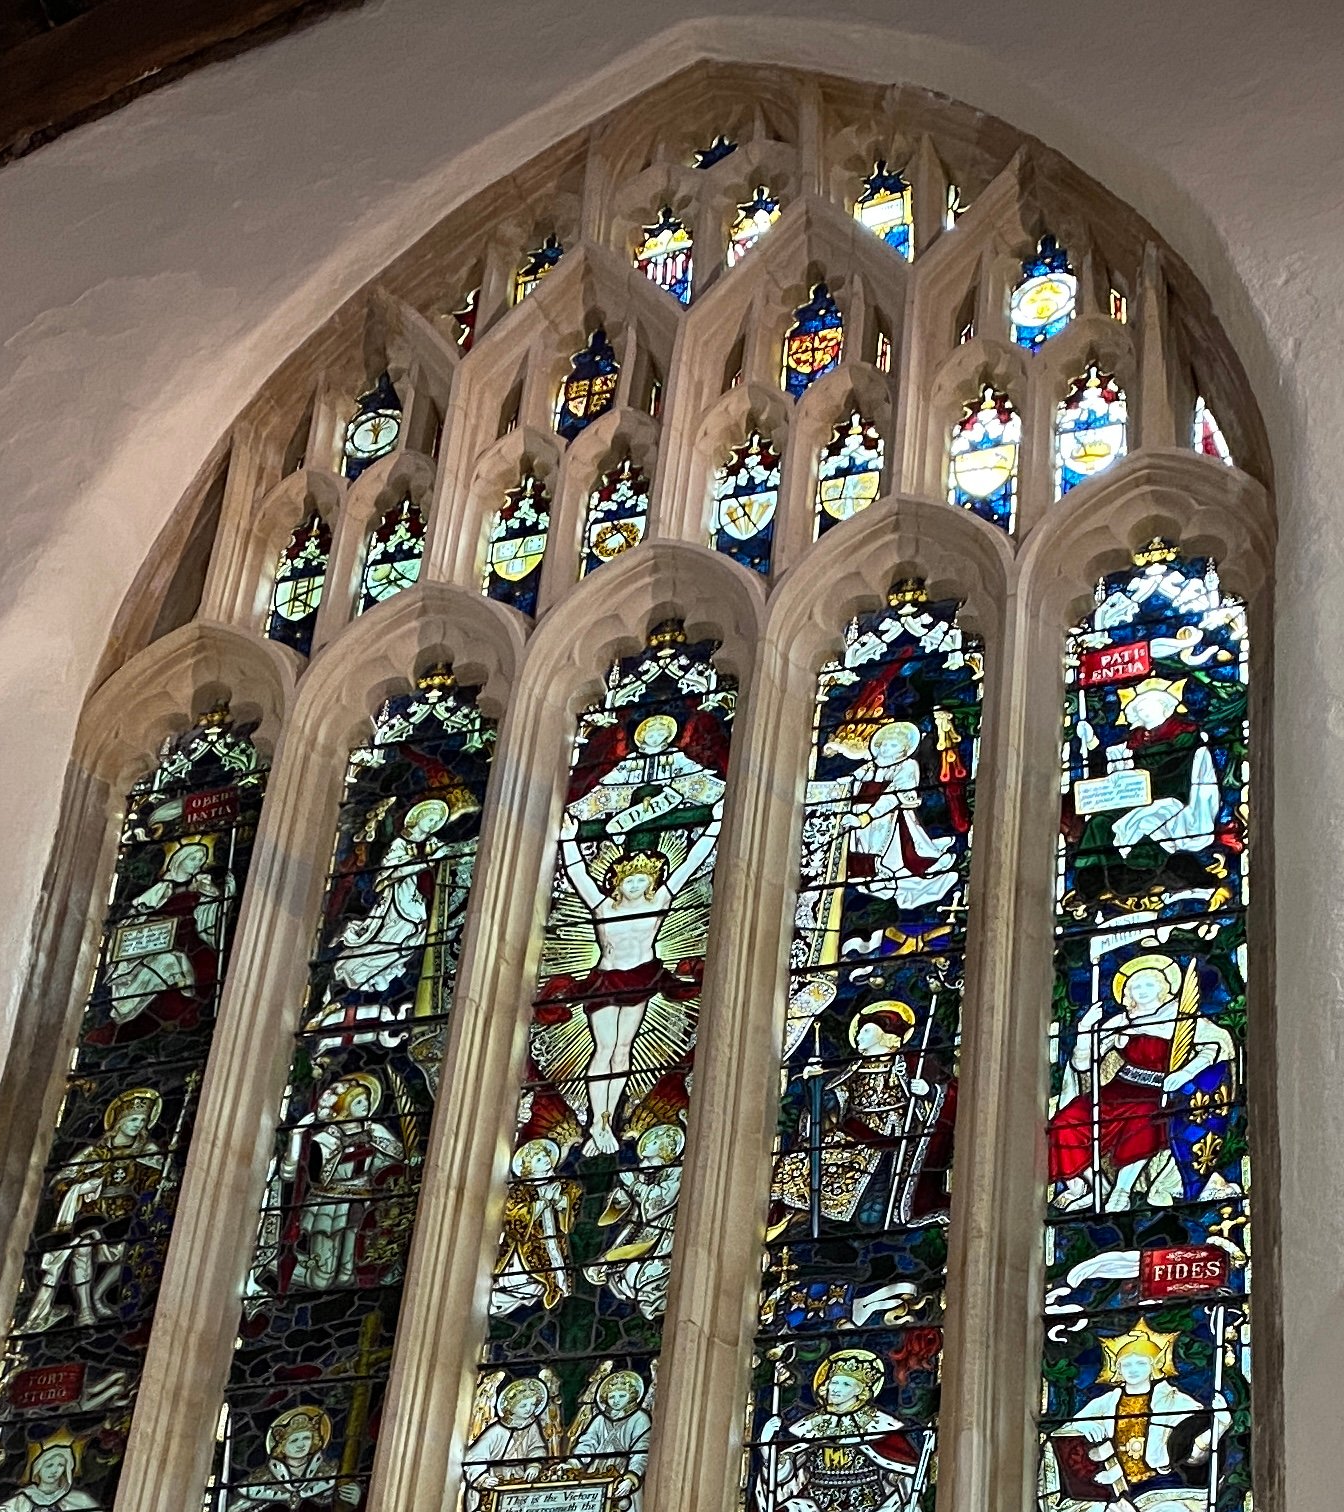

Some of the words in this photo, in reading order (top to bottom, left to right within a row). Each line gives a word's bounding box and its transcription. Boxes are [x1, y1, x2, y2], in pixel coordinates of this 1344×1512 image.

[1154, 1260, 1221, 1282] FIDES
[506, 1494, 528, 1507] This
[544, 1492, 558, 1503] the
[562, 1491, 599, 1505] Victory
